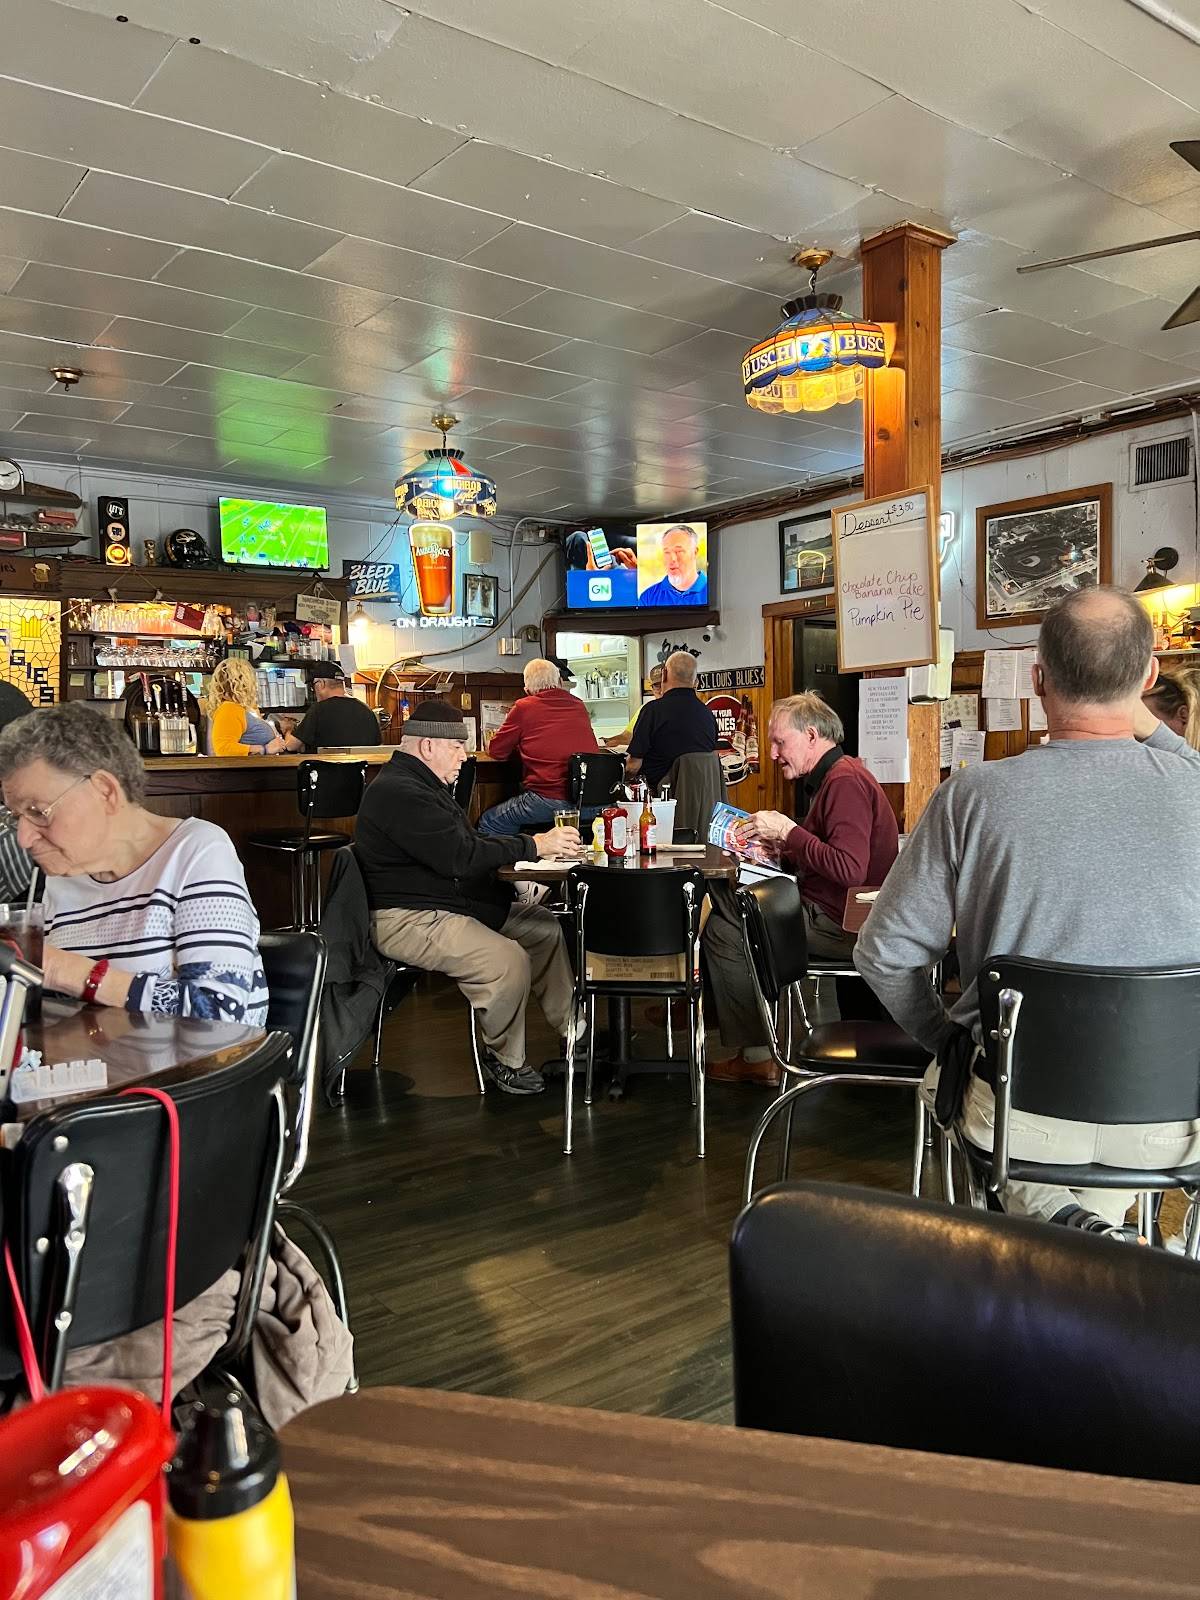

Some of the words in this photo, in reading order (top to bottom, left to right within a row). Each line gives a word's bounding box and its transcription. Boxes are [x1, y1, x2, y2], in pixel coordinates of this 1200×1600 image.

[841, 510, 894, 536] Dessert
[349, 564, 395, 580] BLEED
[355, 579, 390, 595] BLUE
[591, 584, 610, 595] GN
[855, 588, 893, 599] Banana
[900, 584, 927, 597] Cake
[847, 604, 895, 627] Pumpkin
[898, 596, 925, 621] Pie
[397, 617, 416, 628] ON
[420, 616, 480, 628] DRAUGHT
[712, 672, 732, 688] LOUIS
[736, 669, 760, 687] BLUES
[719, 709, 732, 717] YOUR
